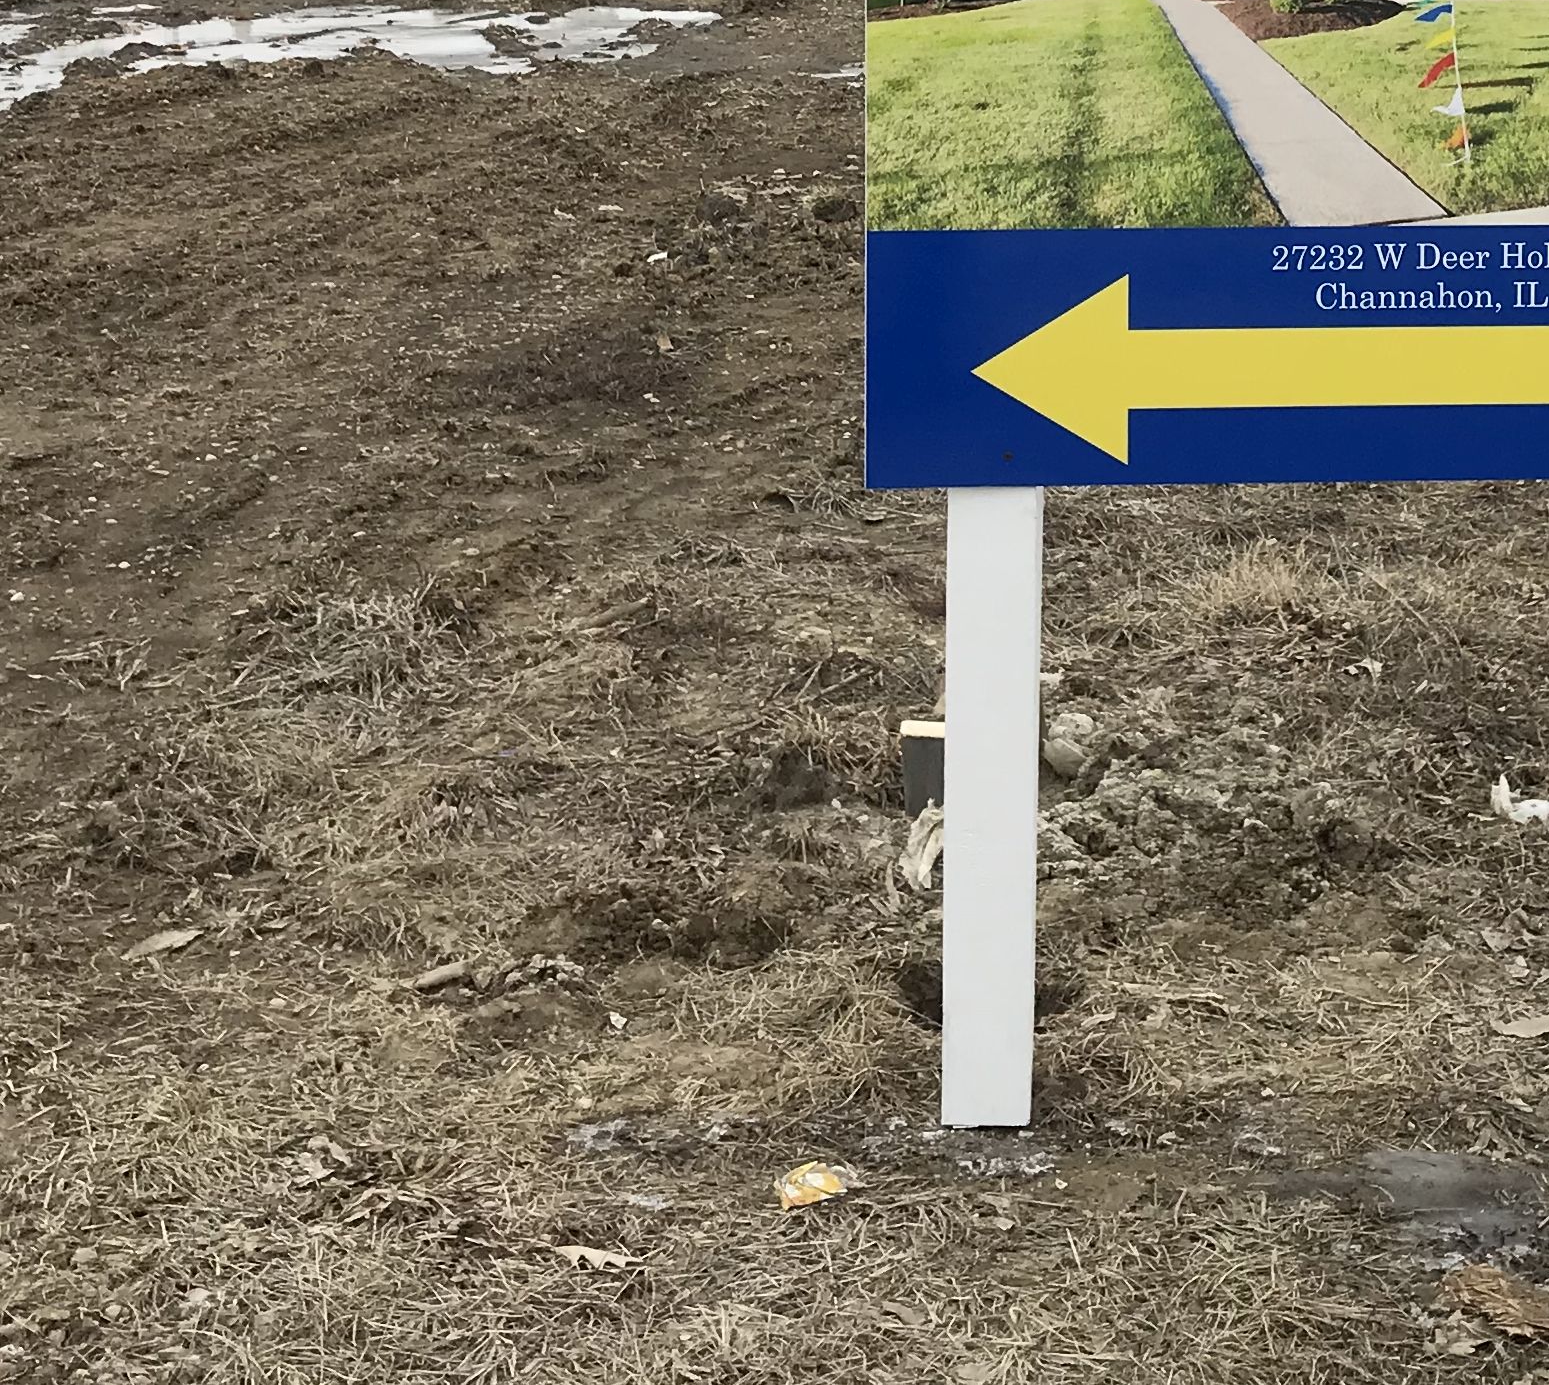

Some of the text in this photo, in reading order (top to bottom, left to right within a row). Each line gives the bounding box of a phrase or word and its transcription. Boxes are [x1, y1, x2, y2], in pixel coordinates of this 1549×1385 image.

[1271, 244, 1364, 271] 27232
[1374, 243, 1405, 269] W
[1416, 243, 1490, 270] Deer
[1315, 282, 1502, 313] Channahon,
[1513, 281, 1549, 307] IL
